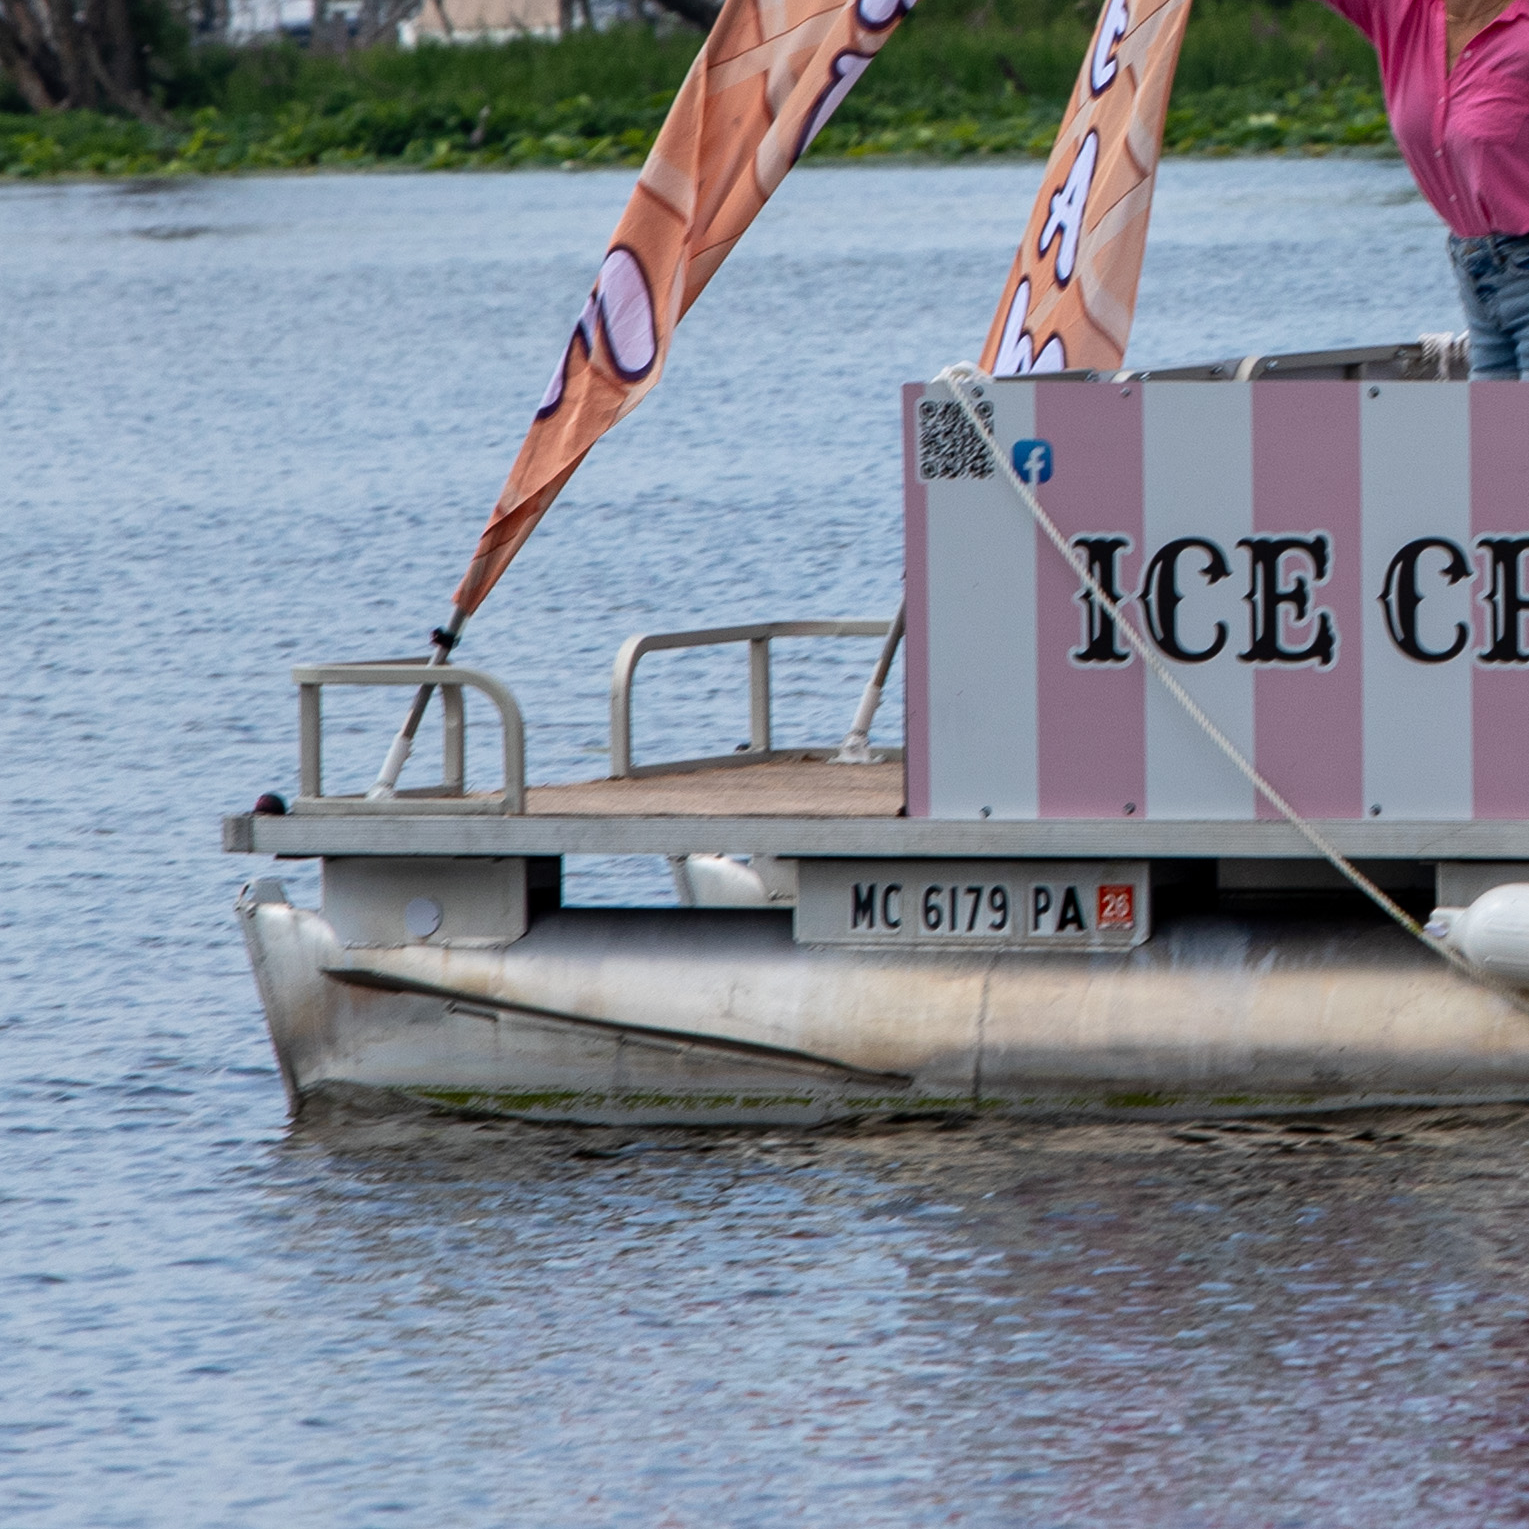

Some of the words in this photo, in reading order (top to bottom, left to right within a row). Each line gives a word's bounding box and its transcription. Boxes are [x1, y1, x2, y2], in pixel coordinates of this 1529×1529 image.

[1071, 536, 1336, 666] ICE
[851, 882, 904, 930] MC
[921, 883, 1009, 933] 6179
[1031, 884, 1088, 933] PA
[1100, 891, 1131, 919] 26
